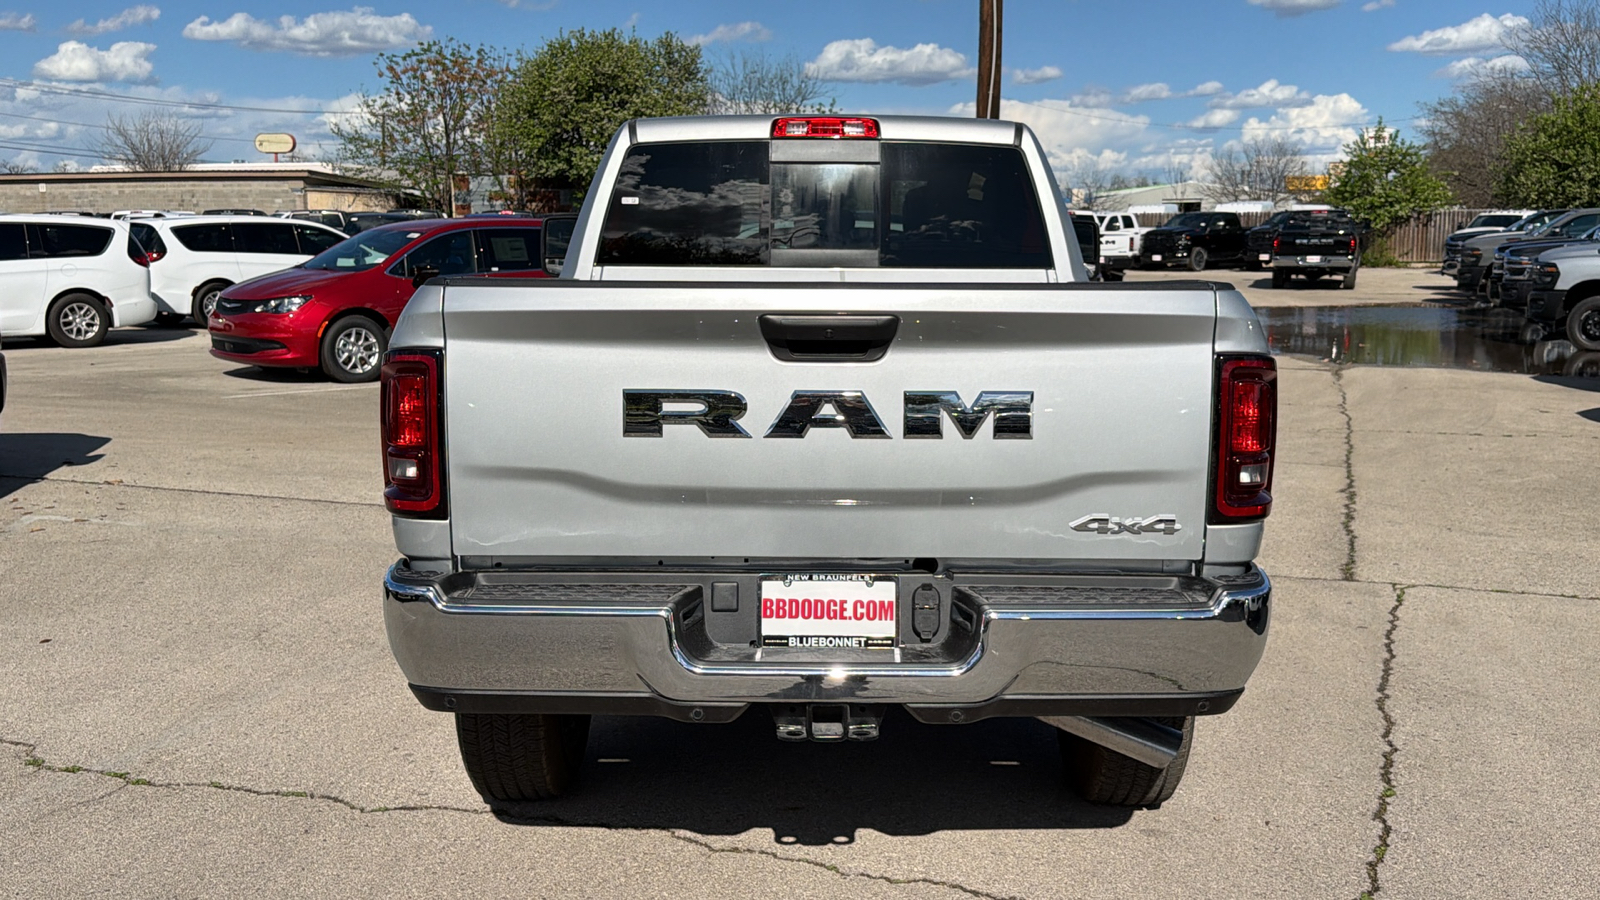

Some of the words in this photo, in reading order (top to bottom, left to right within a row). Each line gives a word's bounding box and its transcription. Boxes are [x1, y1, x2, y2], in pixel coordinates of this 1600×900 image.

[622, 388, 1035, 439] RAM
[762, 598, 894, 621] BBDODGE.COM
[788, 637, 867, 647] BLUEBONNET
